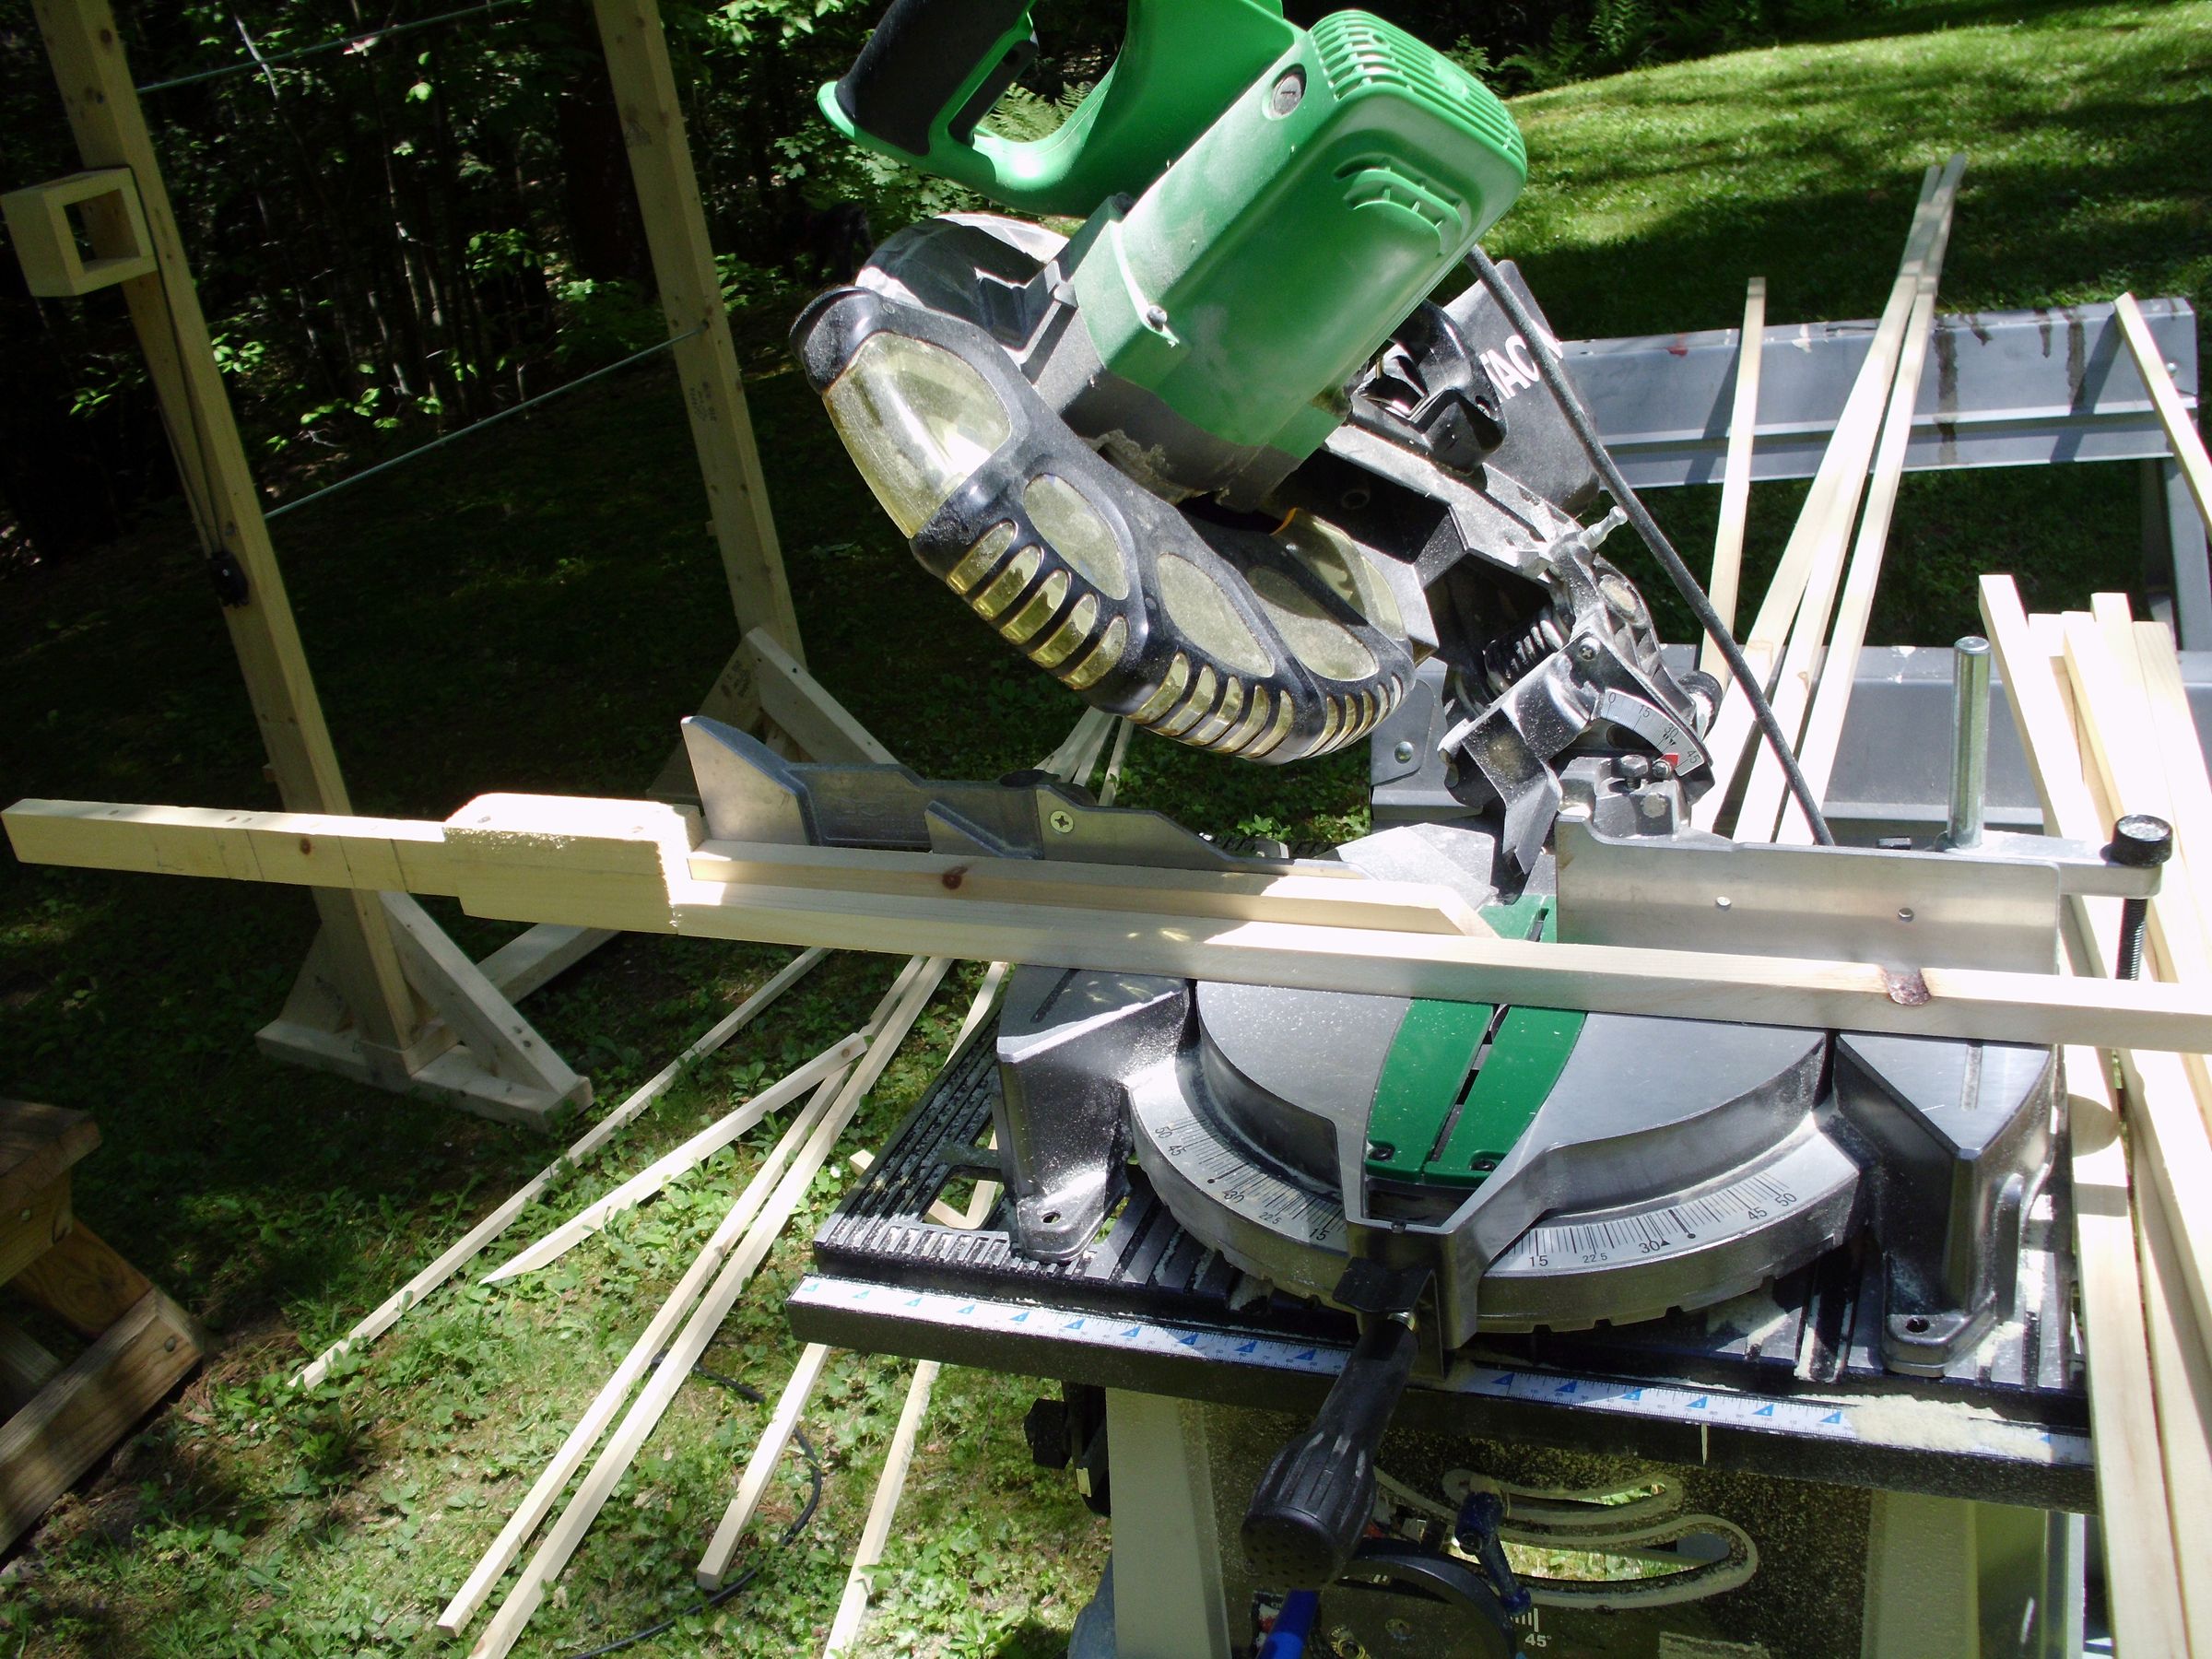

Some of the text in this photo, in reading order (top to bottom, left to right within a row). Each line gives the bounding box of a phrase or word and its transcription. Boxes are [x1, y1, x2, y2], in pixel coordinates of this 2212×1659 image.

[1608, 692, 1616, 703] 0
[1638, 704, 1652, 718] 15
[1664, 723, 1678, 737] 30
[1687, 749, 1700, 764] 45
[1155, 1126, 1173, 1139] 50
[1168, 1143, 1187, 1157] 45
[1223, 1191, 1244, 1204] 30
[1774, 1193, 1797, 1207] 50
[1747, 1206, 1768, 1221] 45
[1309, 1228, 1330, 1241] 15
[1638, 1240, 1660, 1254] 30
[1528, 1254, 1549, 1267] 15
